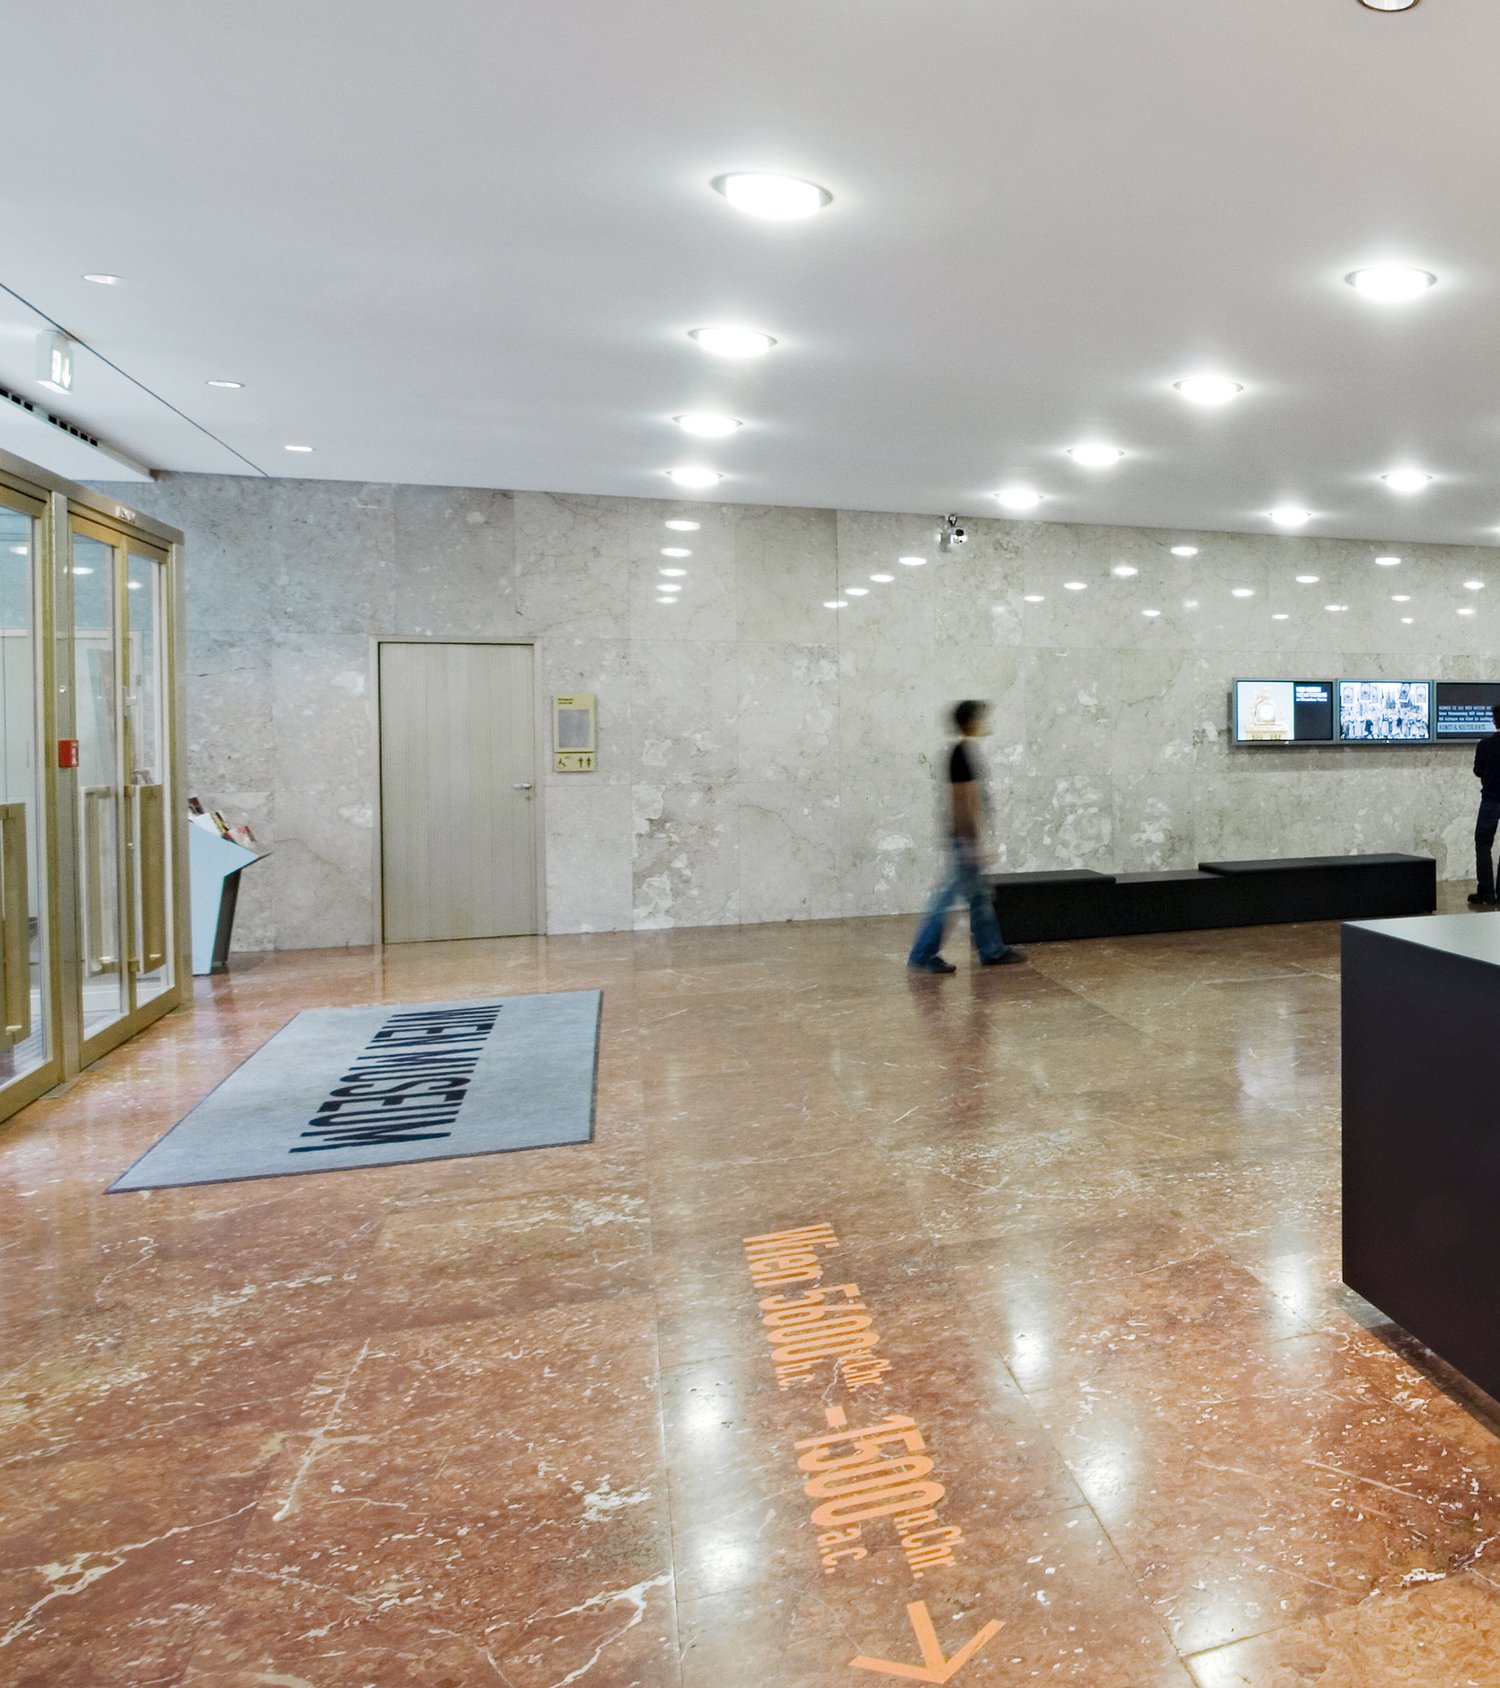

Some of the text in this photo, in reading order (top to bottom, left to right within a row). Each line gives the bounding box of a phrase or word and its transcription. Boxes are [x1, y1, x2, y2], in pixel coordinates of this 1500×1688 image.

[288, 1005, 503, 1154] WIEN MUSEUM
[742, 1222, 840, 1288] Wien
[758, 1283, 880, 1362] 5600
[794, 1414, 945, 1526] 1500
